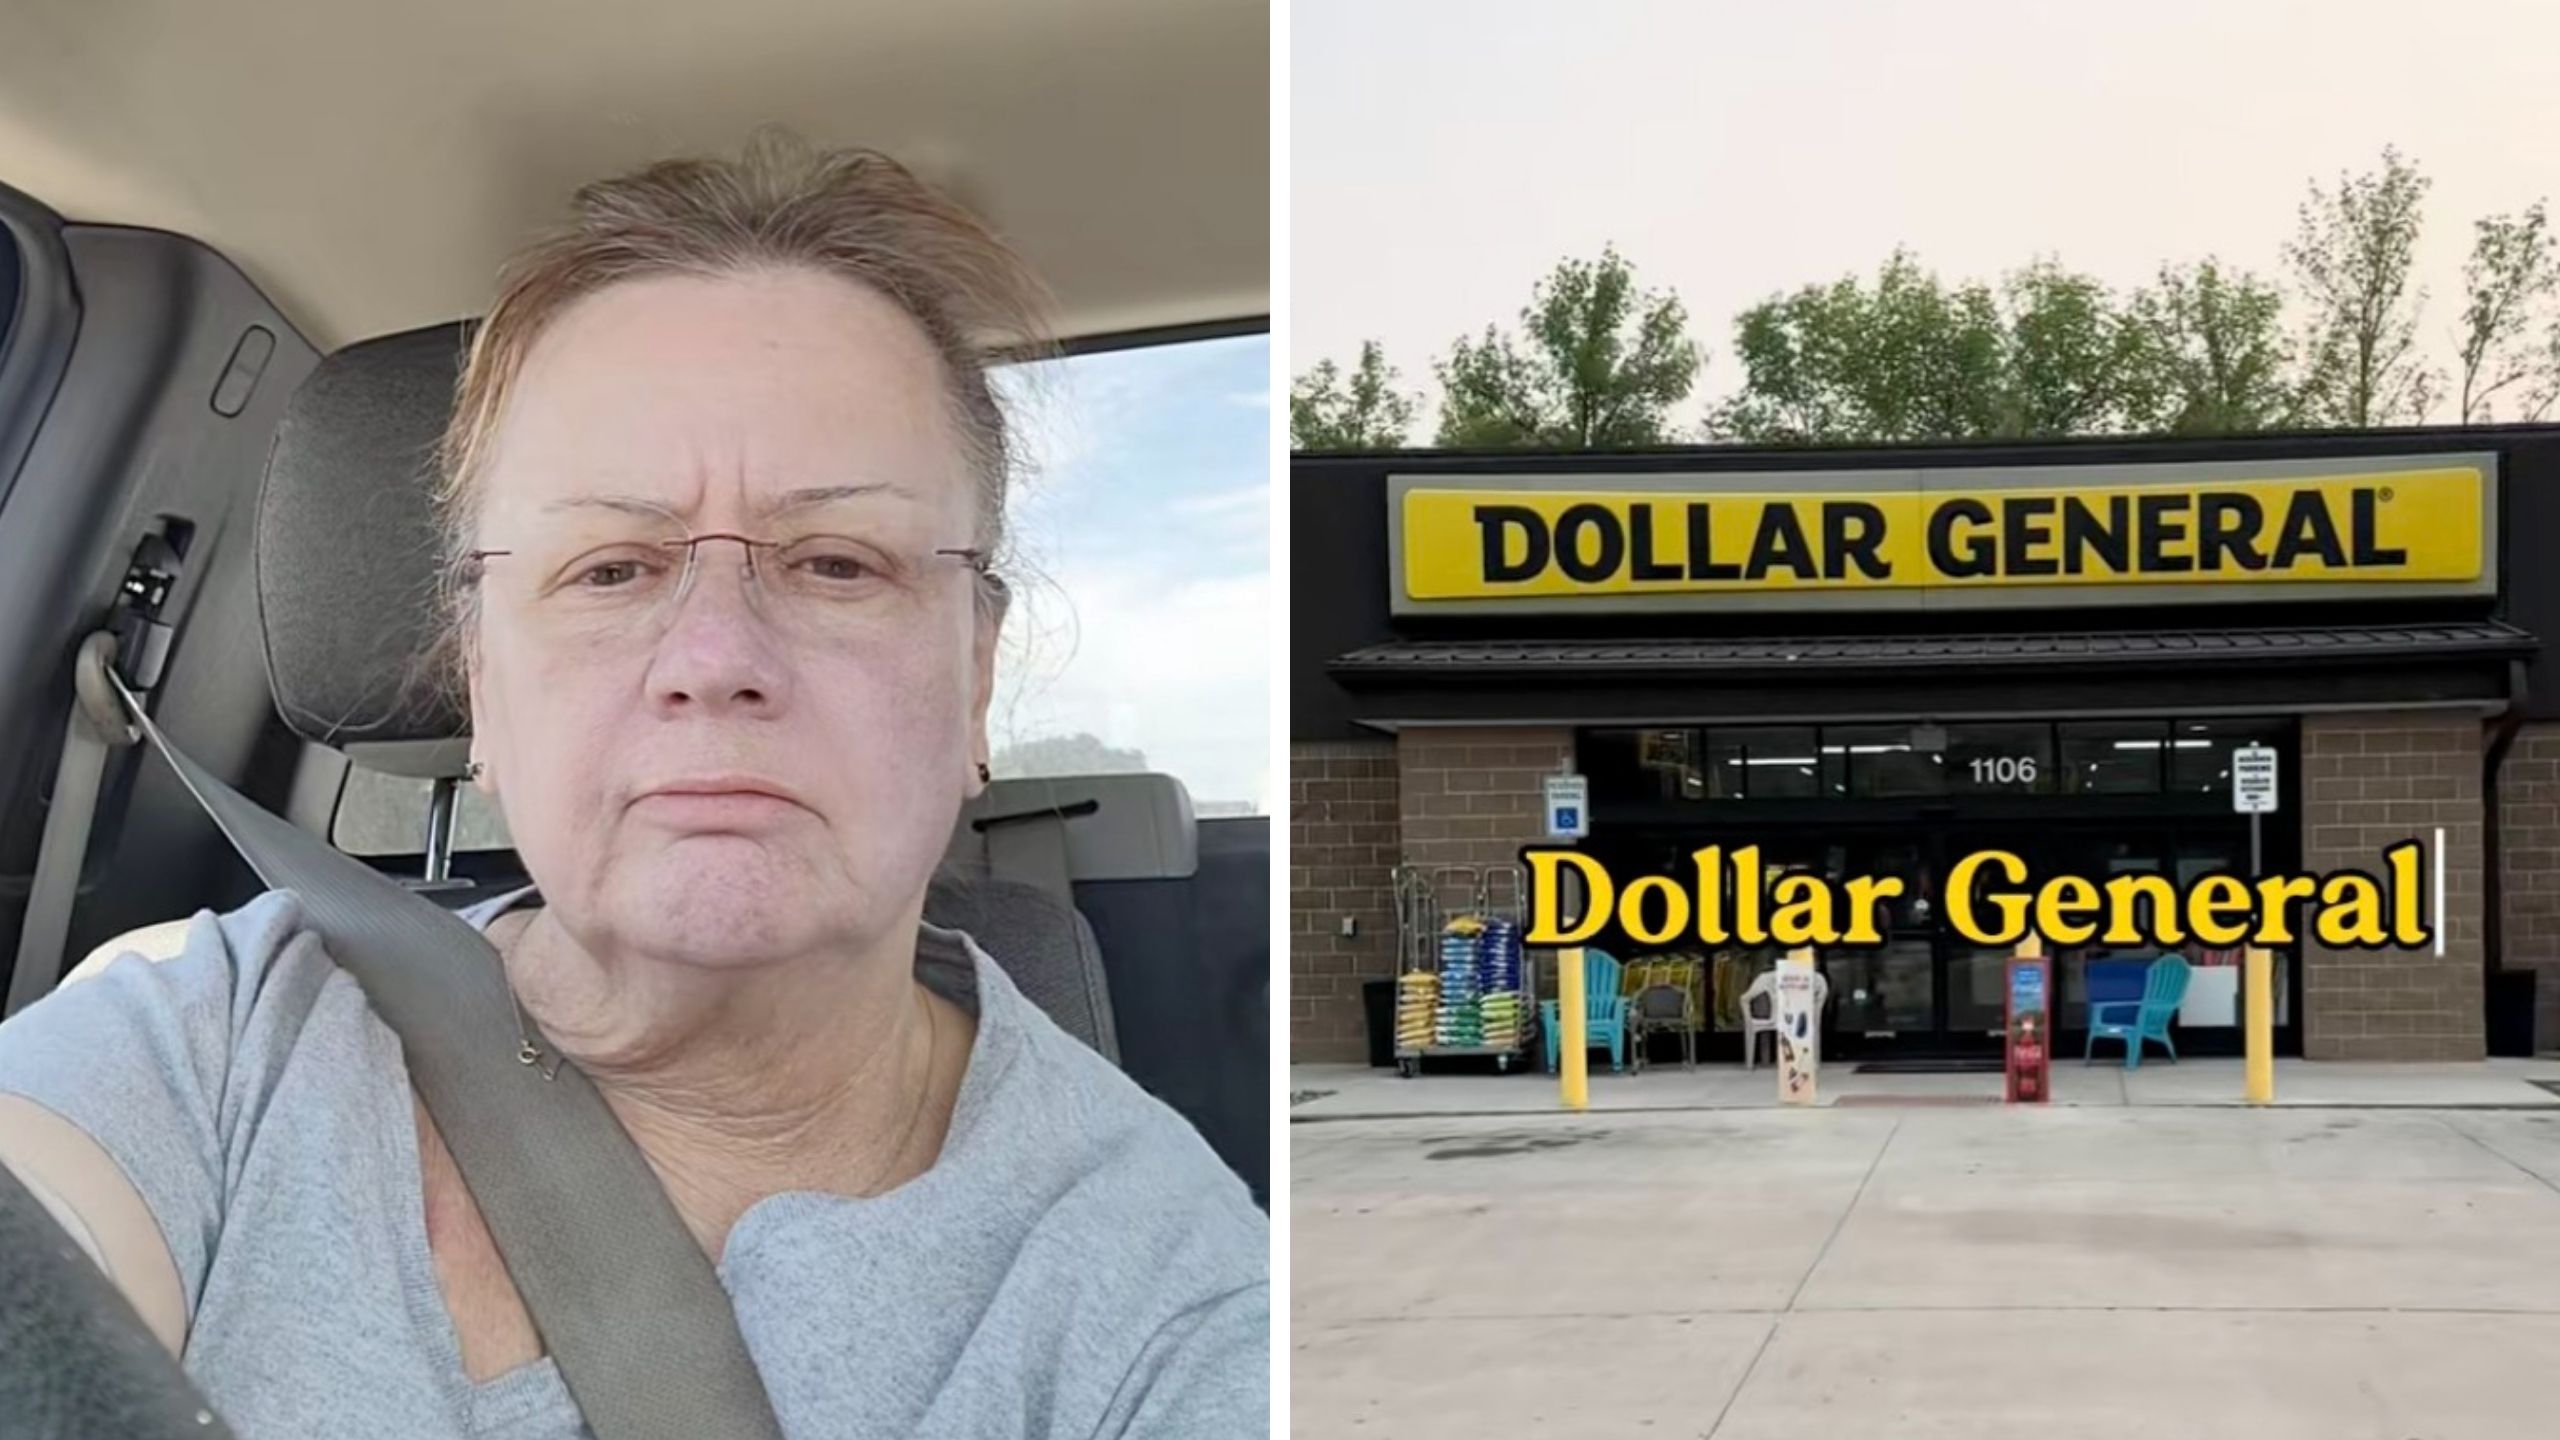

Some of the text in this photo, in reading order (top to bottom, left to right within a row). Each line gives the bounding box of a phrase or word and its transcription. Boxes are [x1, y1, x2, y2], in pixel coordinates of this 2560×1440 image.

[1474, 488, 2407, 583] DOLLAR GENERAL
[1968, 757, 2037, 783] 1106
